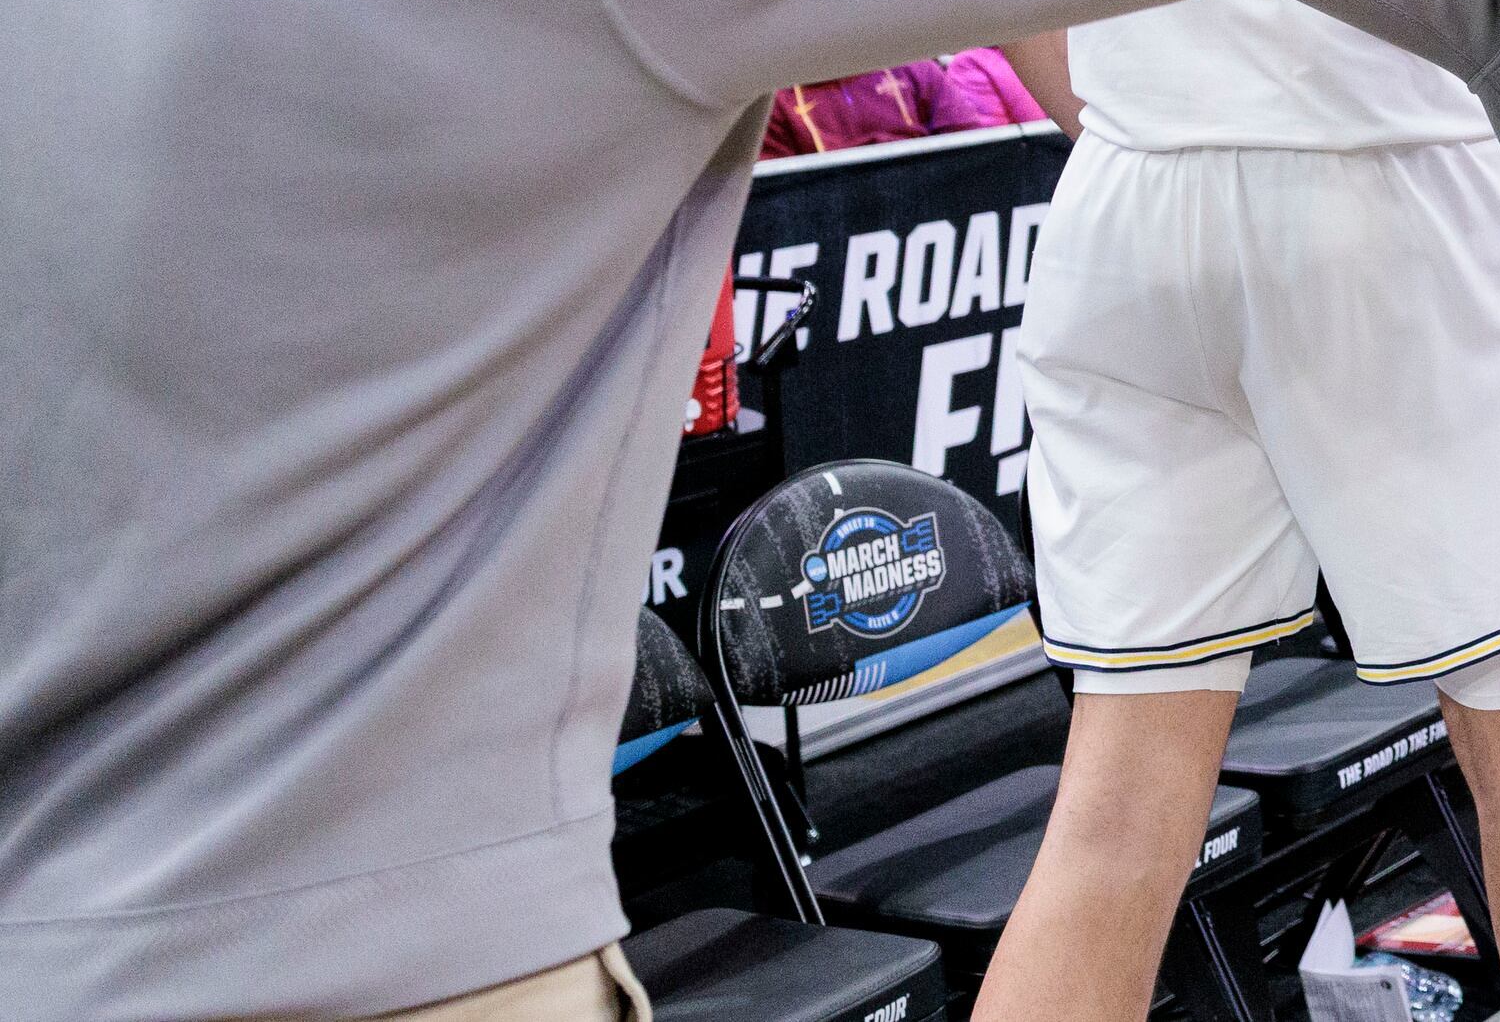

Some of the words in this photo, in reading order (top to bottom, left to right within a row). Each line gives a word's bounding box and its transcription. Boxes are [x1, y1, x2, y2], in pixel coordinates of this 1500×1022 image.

[837, 202, 1051, 343] ROAD
[827, 534, 900, 580] MARCH
[843, 549, 941, 604] MADNESS
[1338, 761, 1362, 790] THE
[1362, 746, 1394, 778] ROAD
[1393, 737, 1408, 762] TO
[1408, 727, 1428, 754] THE
[1204, 828, 1238, 864] FOUR
